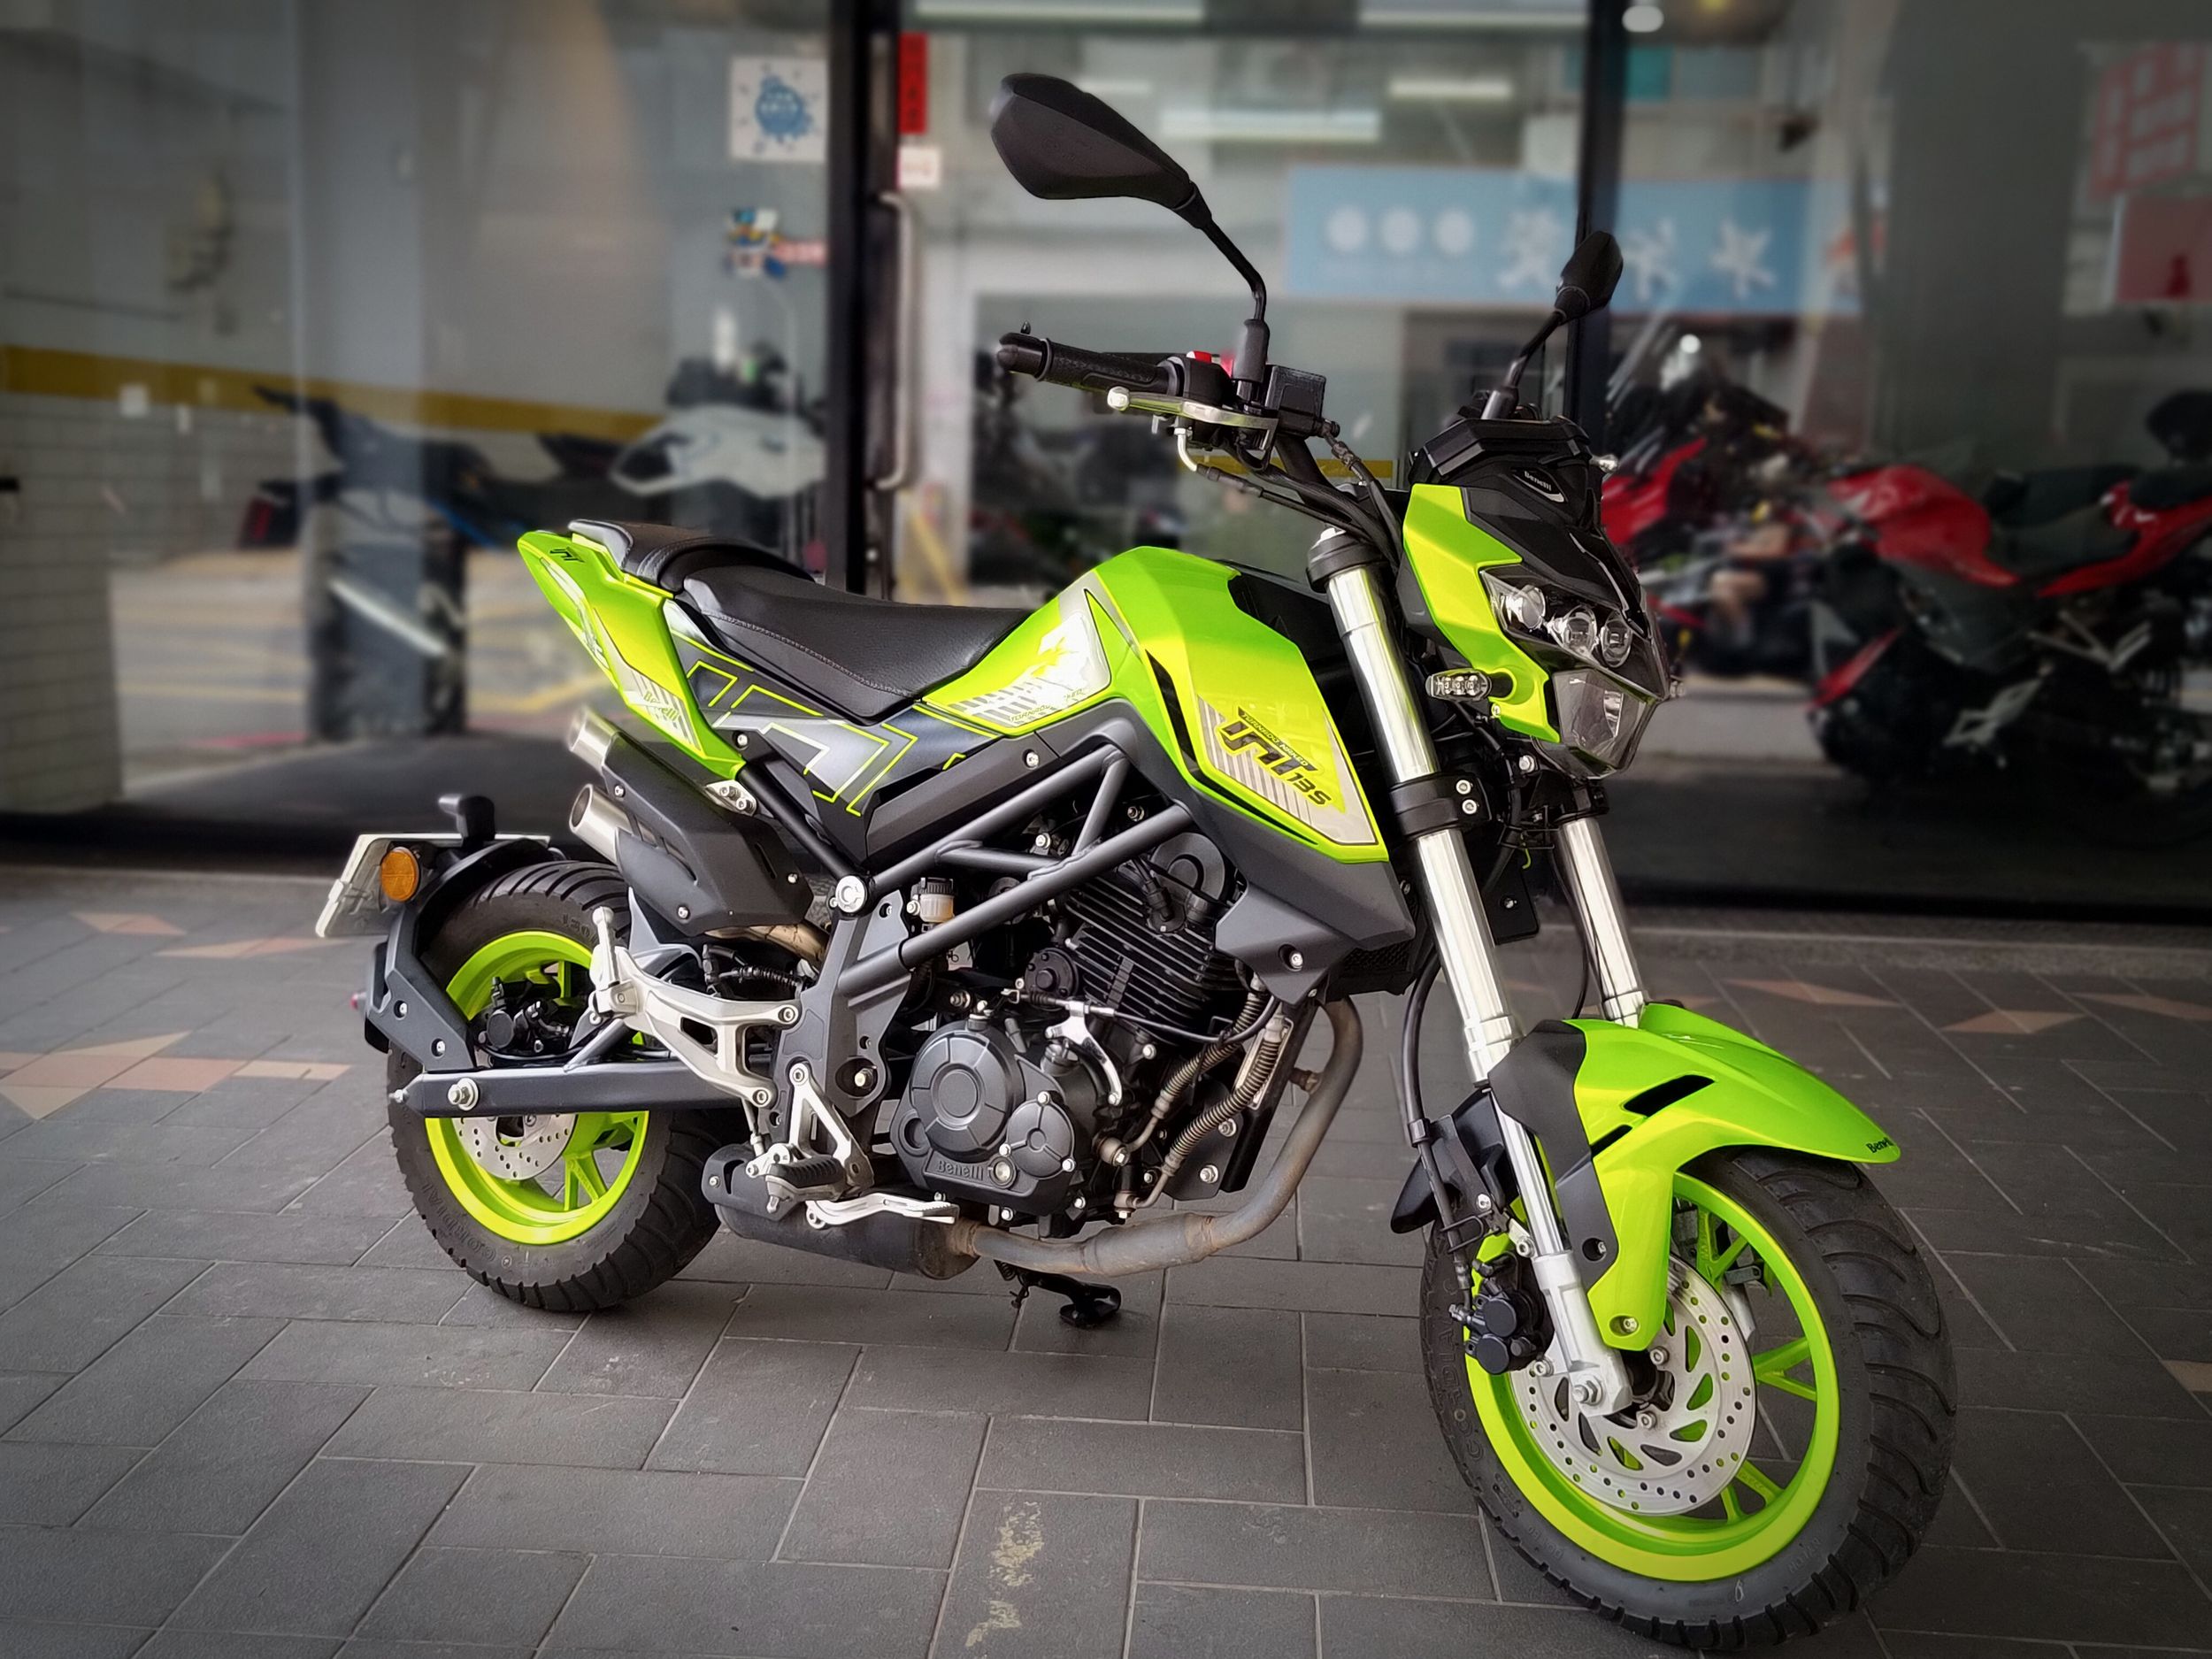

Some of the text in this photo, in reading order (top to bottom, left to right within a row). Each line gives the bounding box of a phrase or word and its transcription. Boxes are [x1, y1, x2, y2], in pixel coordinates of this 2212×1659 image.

[643, 690, 680, 721] Beelli
[1219, 705, 1318, 776] TNT
[937, 1159, 985, 1181] Benelli
